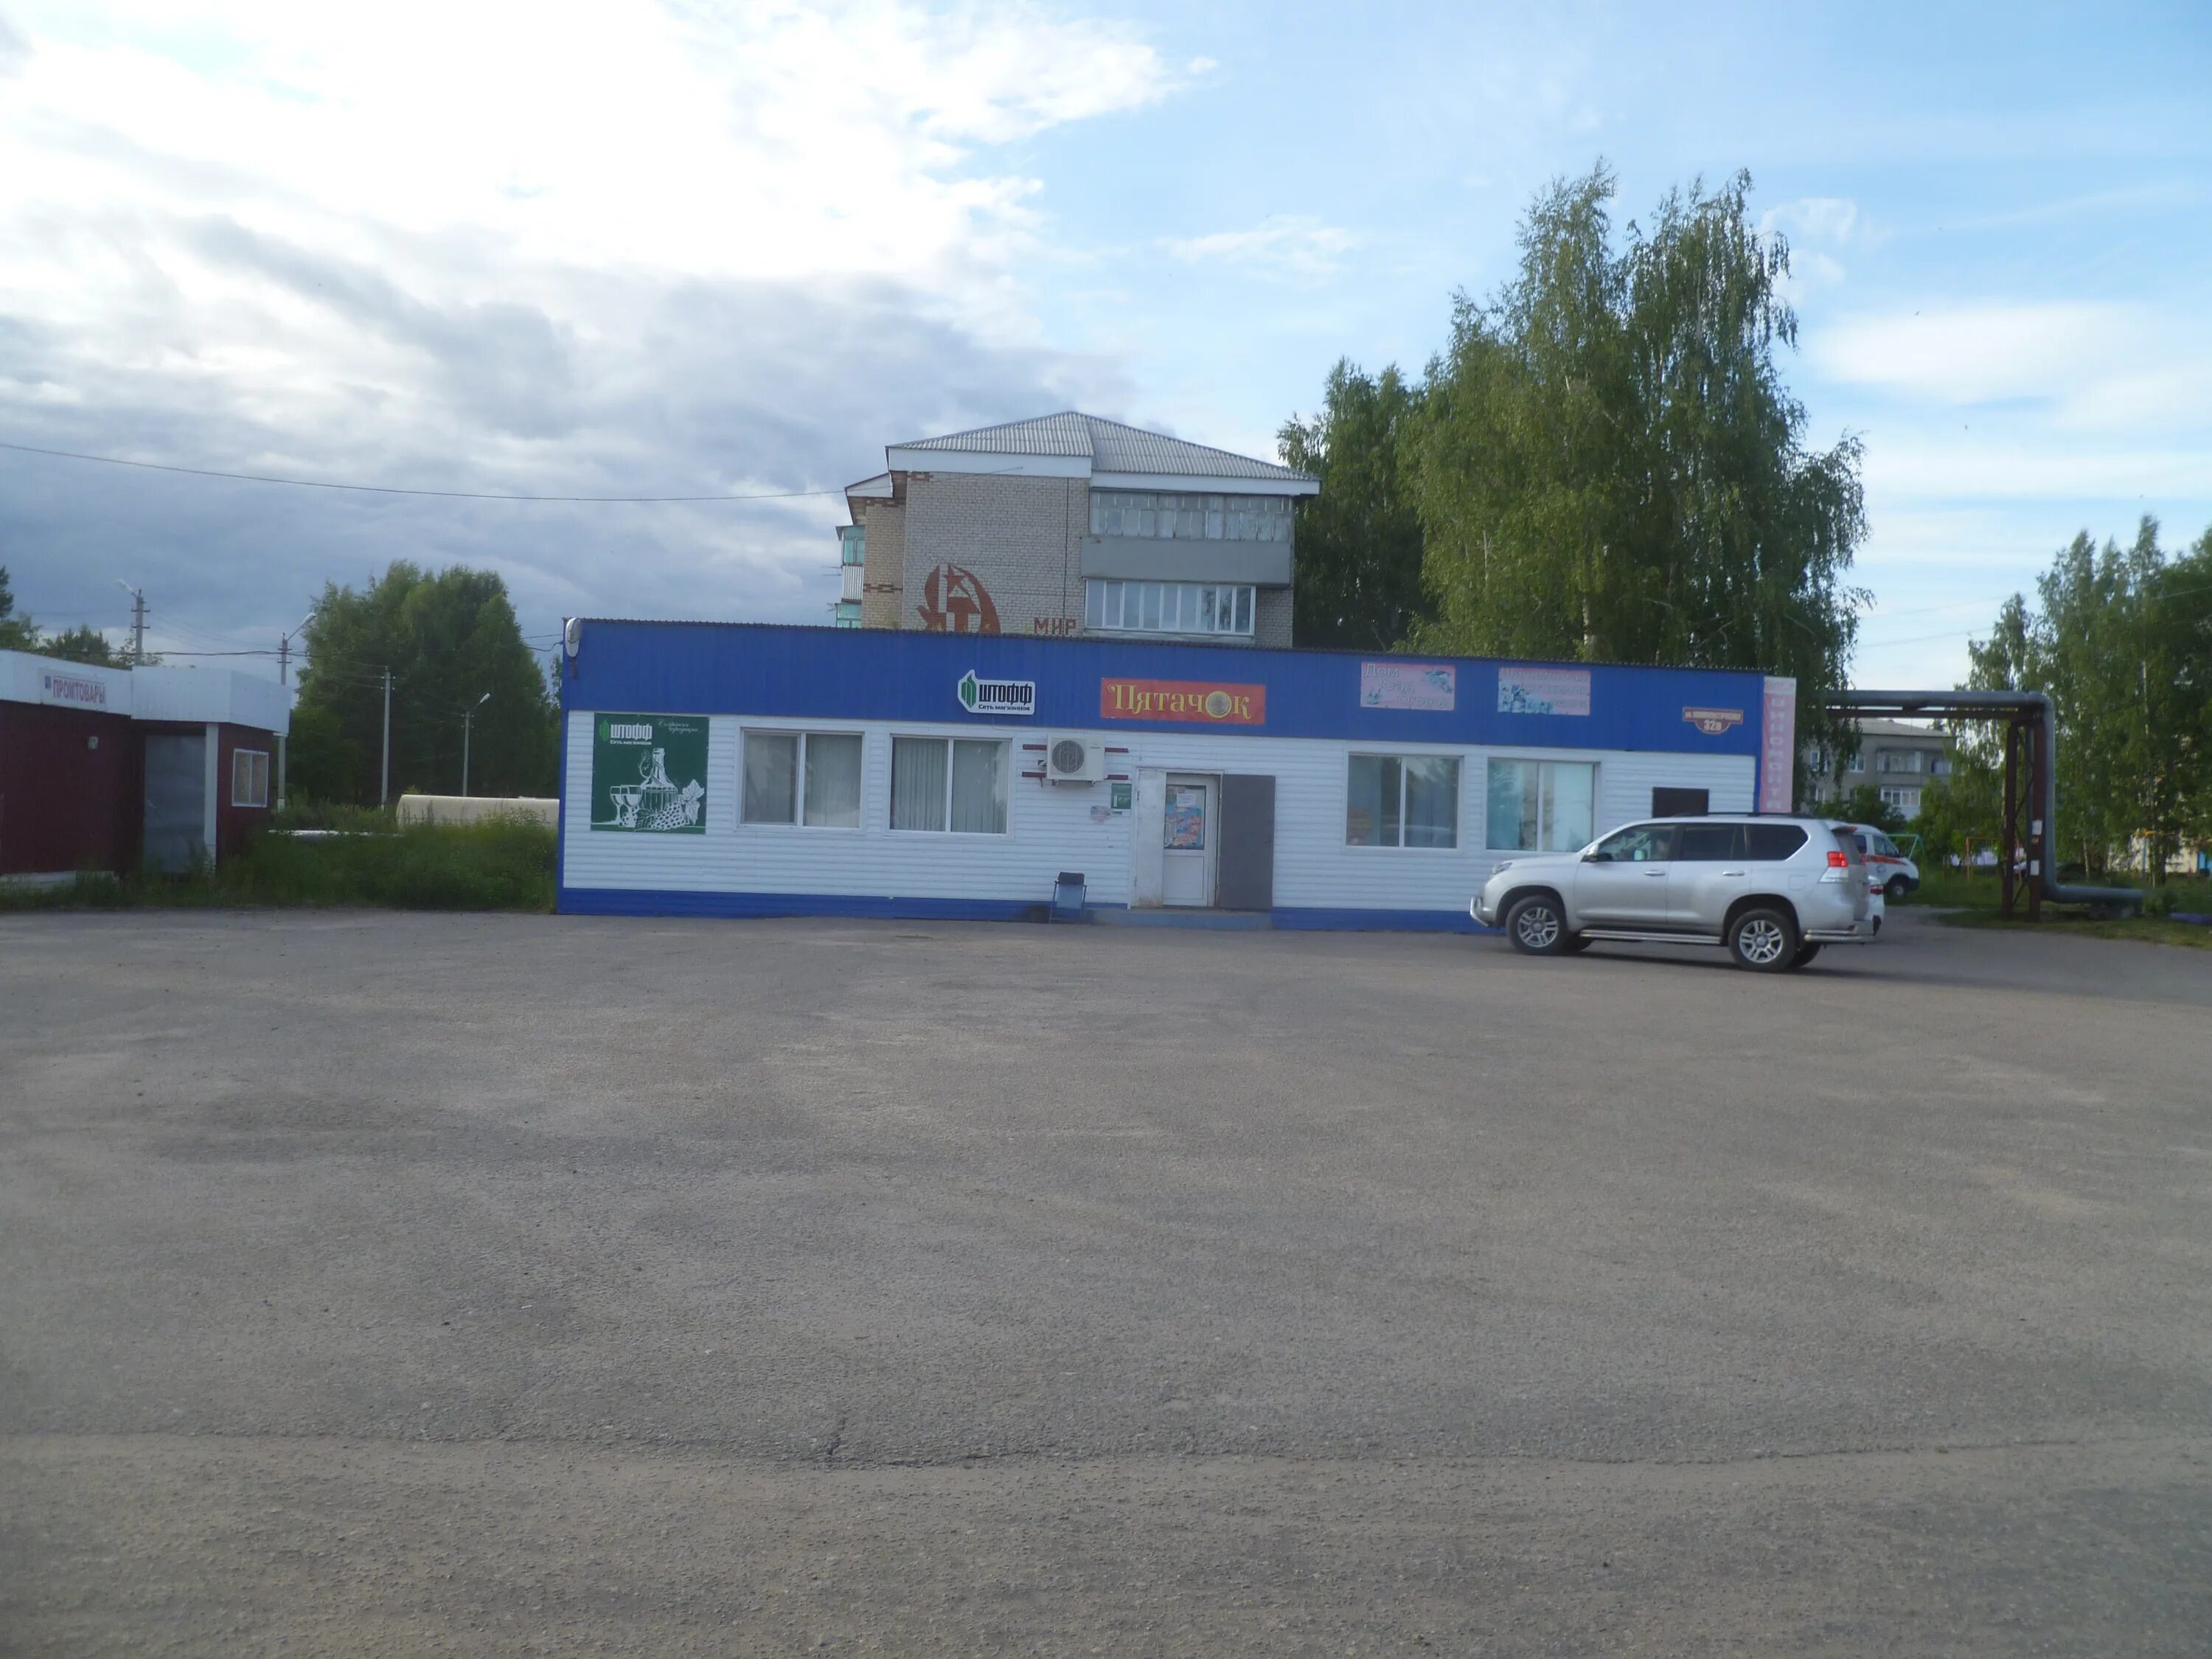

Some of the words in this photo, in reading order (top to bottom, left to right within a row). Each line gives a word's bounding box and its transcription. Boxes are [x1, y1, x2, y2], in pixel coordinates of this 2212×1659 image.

[1034, 618, 1077, 636] МИР
[53, 679, 106, 704] ПРОМТОВАРЫ
[1108, 684, 1252, 720] Пятачок
